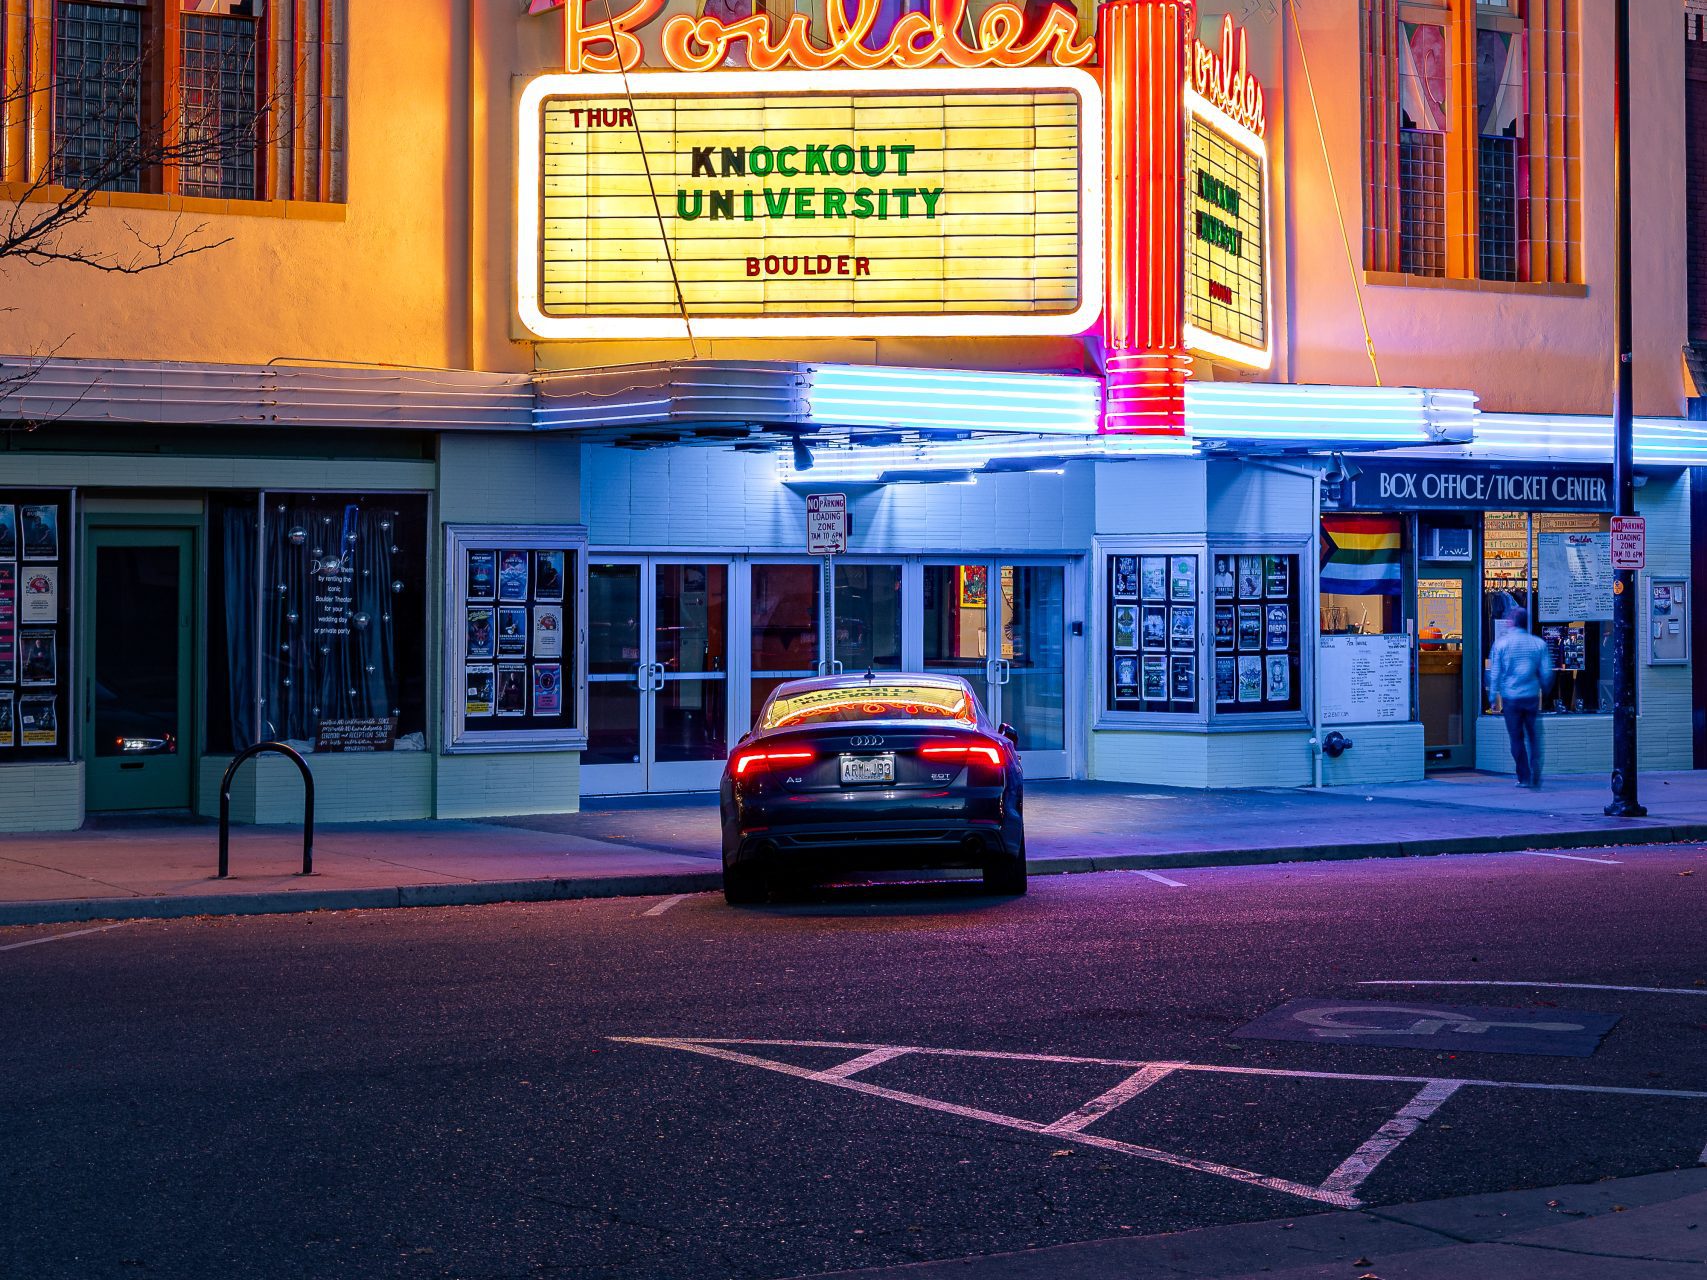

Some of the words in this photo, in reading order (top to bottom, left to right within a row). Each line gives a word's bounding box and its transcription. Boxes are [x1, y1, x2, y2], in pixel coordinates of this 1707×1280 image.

[569, 108, 634, 129] THUR
[691, 144, 915, 178] KNOCKOUT
[677, 187, 944, 221] UNIVERSITY
[746, 254, 870, 276] BOULDER
[1380, 472, 1417, 498] BOX
[1552, 477, 1607, 502] CENTER
[808, 499, 819, 510] NO
[820, 500, 844, 508] PARKING
[812, 512, 840, 520] LOADING
[818, 522, 836, 530] ZONE
[1612, 521, 1622, 530] NO
[832, 531, 842, 539] 6PM
[1568, 534, 1593, 544] Boulder
[1268, 624, 1286, 632] DISCO
